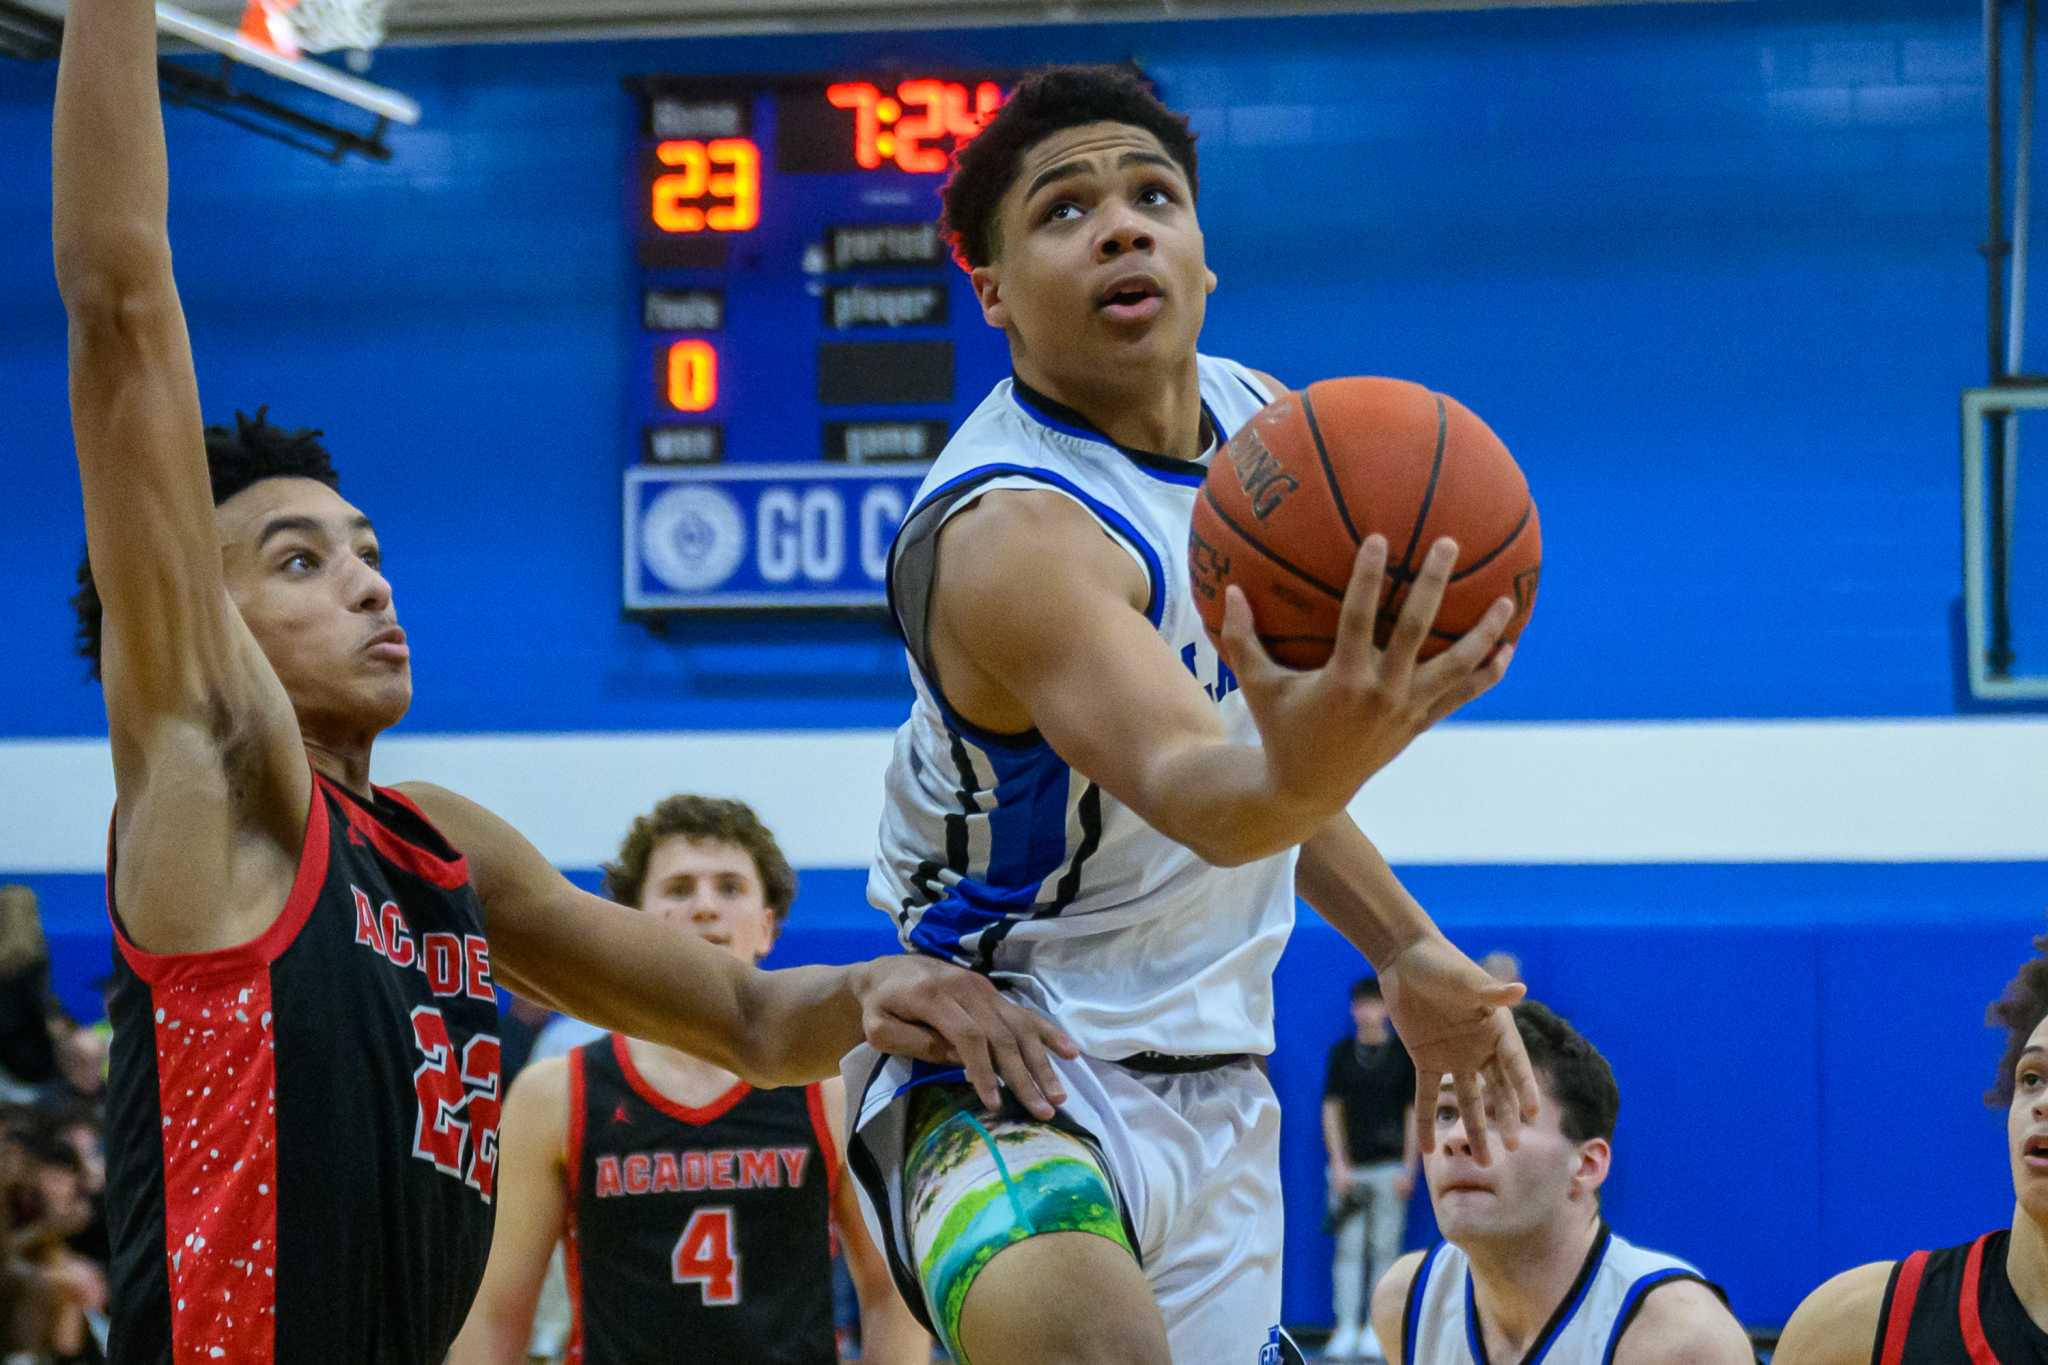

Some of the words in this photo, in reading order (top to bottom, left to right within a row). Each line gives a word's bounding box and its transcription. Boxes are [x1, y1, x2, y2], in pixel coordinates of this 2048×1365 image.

[652, 138, 761, 233] 23
[668, 338, 718, 413] 0
[757, 487, 844, 582] GO
[350, 883, 497, 1004] ACDE
[410, 1004, 500, 1205] 22
[595, 1147, 808, 1198] ACADEMY
[671, 1207, 740, 1306] 4
